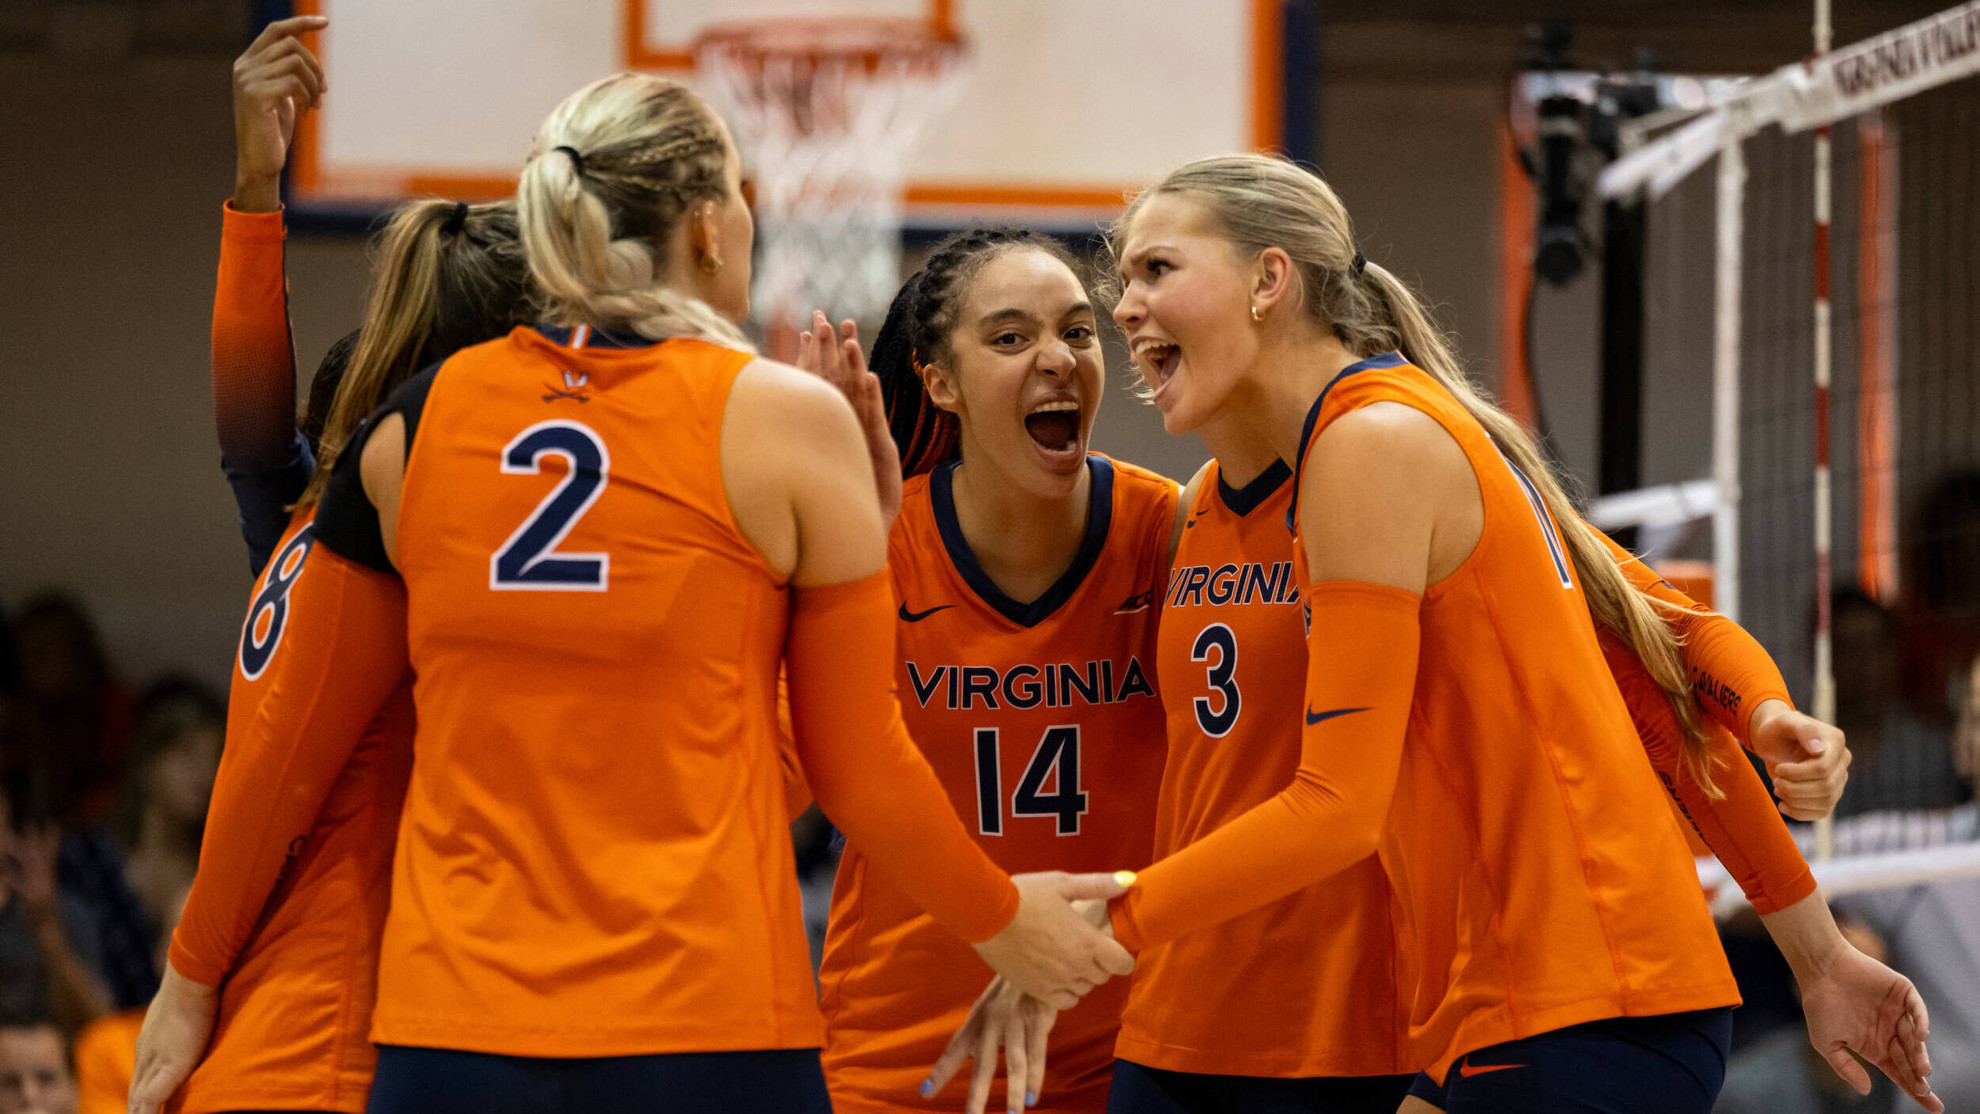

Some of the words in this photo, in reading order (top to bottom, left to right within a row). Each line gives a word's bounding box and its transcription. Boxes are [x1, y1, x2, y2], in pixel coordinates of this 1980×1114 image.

[490, 418, 610, 592] 2
[239, 521, 314, 682] 8
[906, 655, 1156, 710] VIRGINIA
[1191, 622, 1242, 739] 3
[973, 723, 1089, 837] 14
